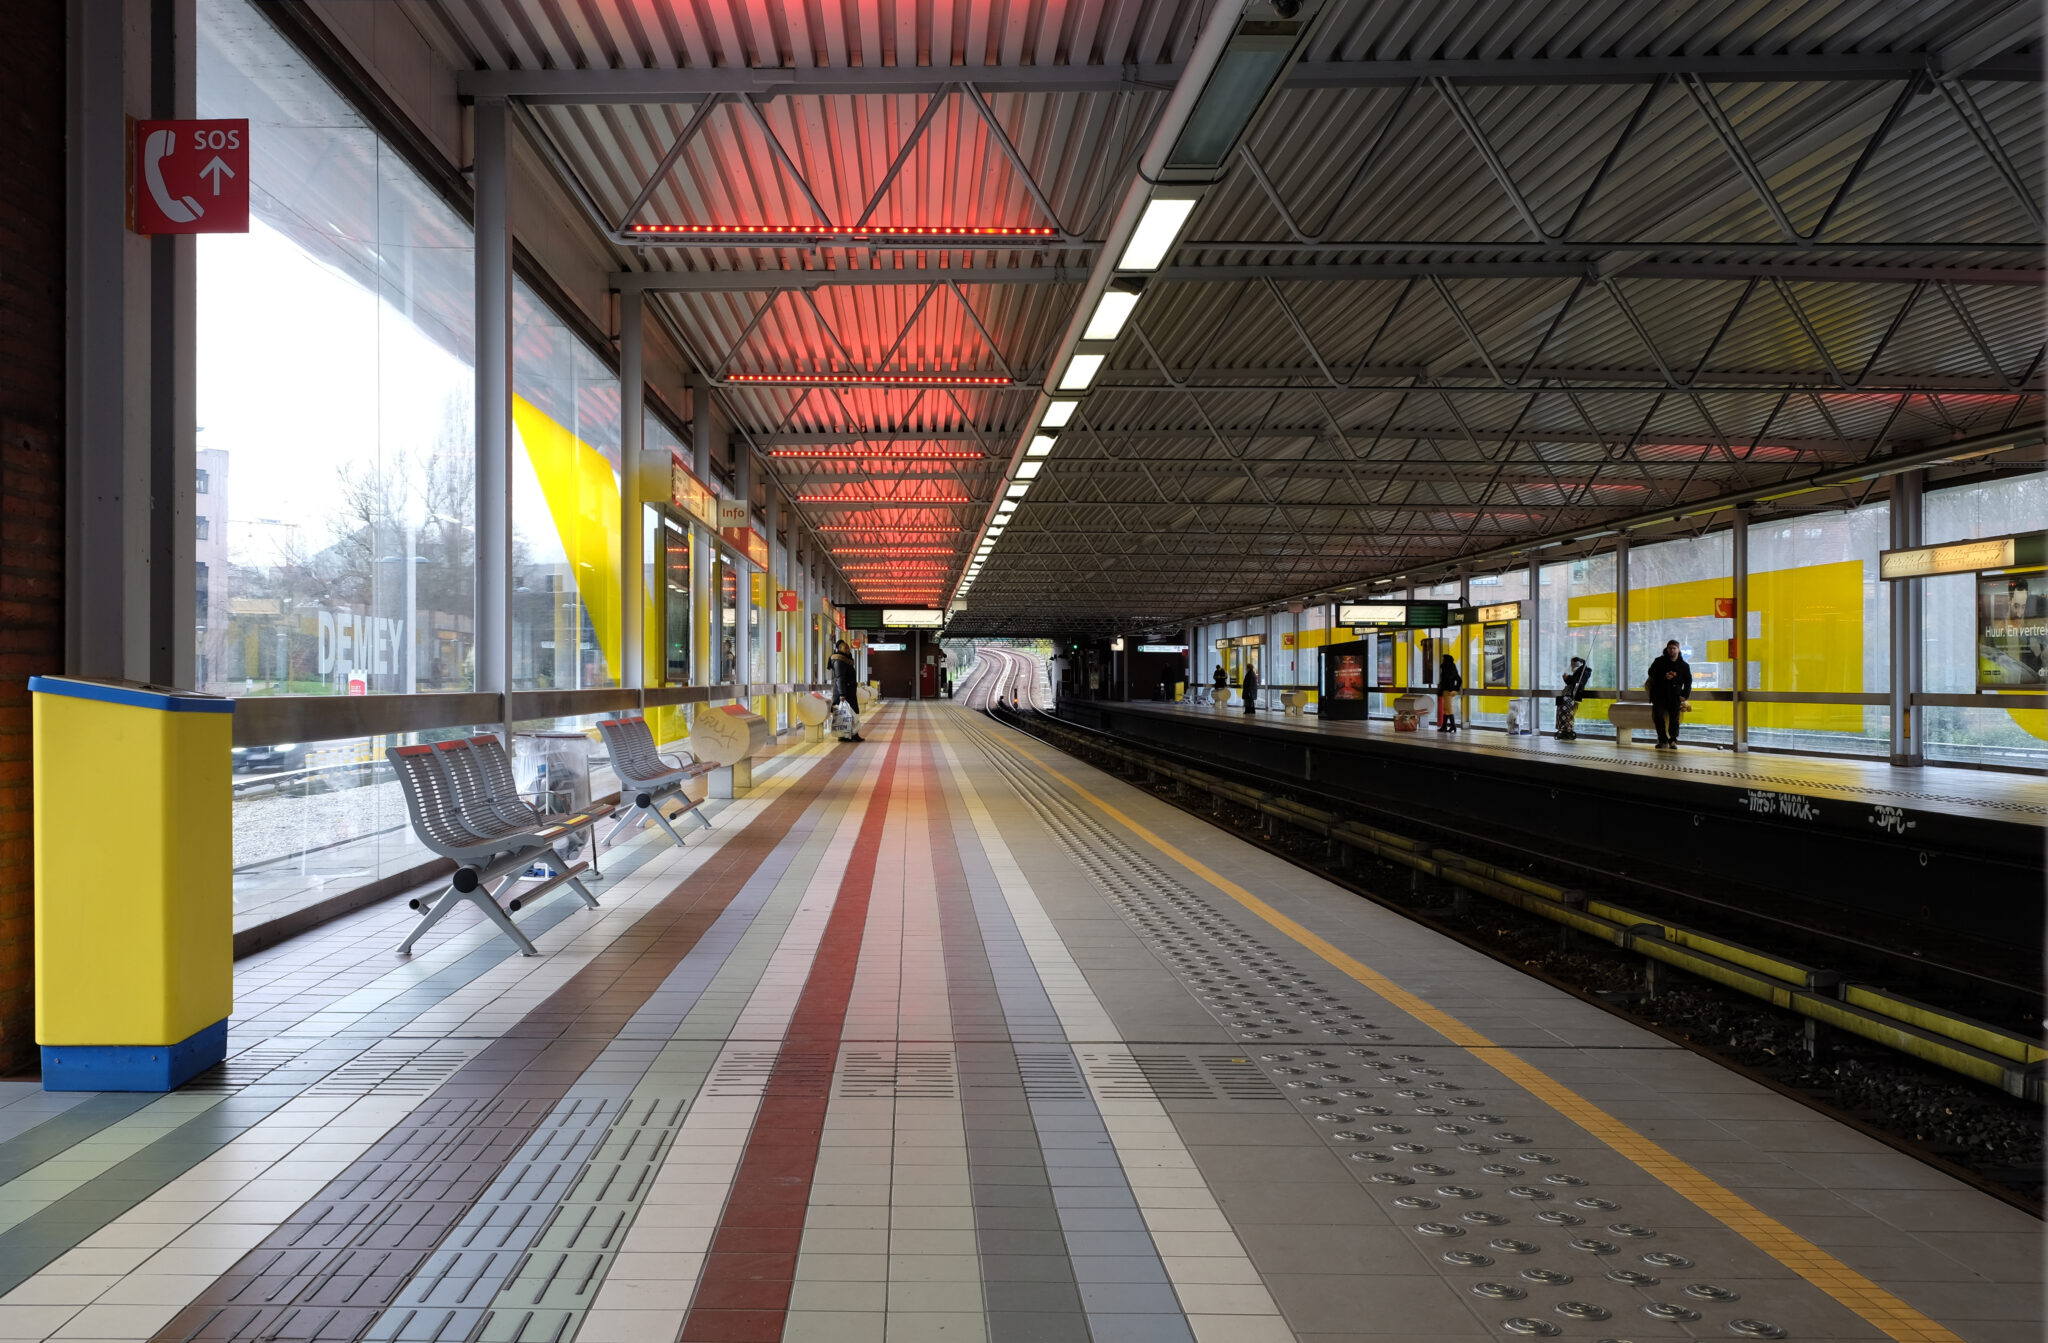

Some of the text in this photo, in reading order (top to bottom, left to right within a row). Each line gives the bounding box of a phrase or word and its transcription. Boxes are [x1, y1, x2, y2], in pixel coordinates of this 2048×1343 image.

[194, 129, 240, 150] SOS
[722, 507, 745, 520] Info
[1985, 625, 2006, 638] Huur.
[2007, 624, 2018, 637] En
[318, 610, 404, 675] DEMEY
